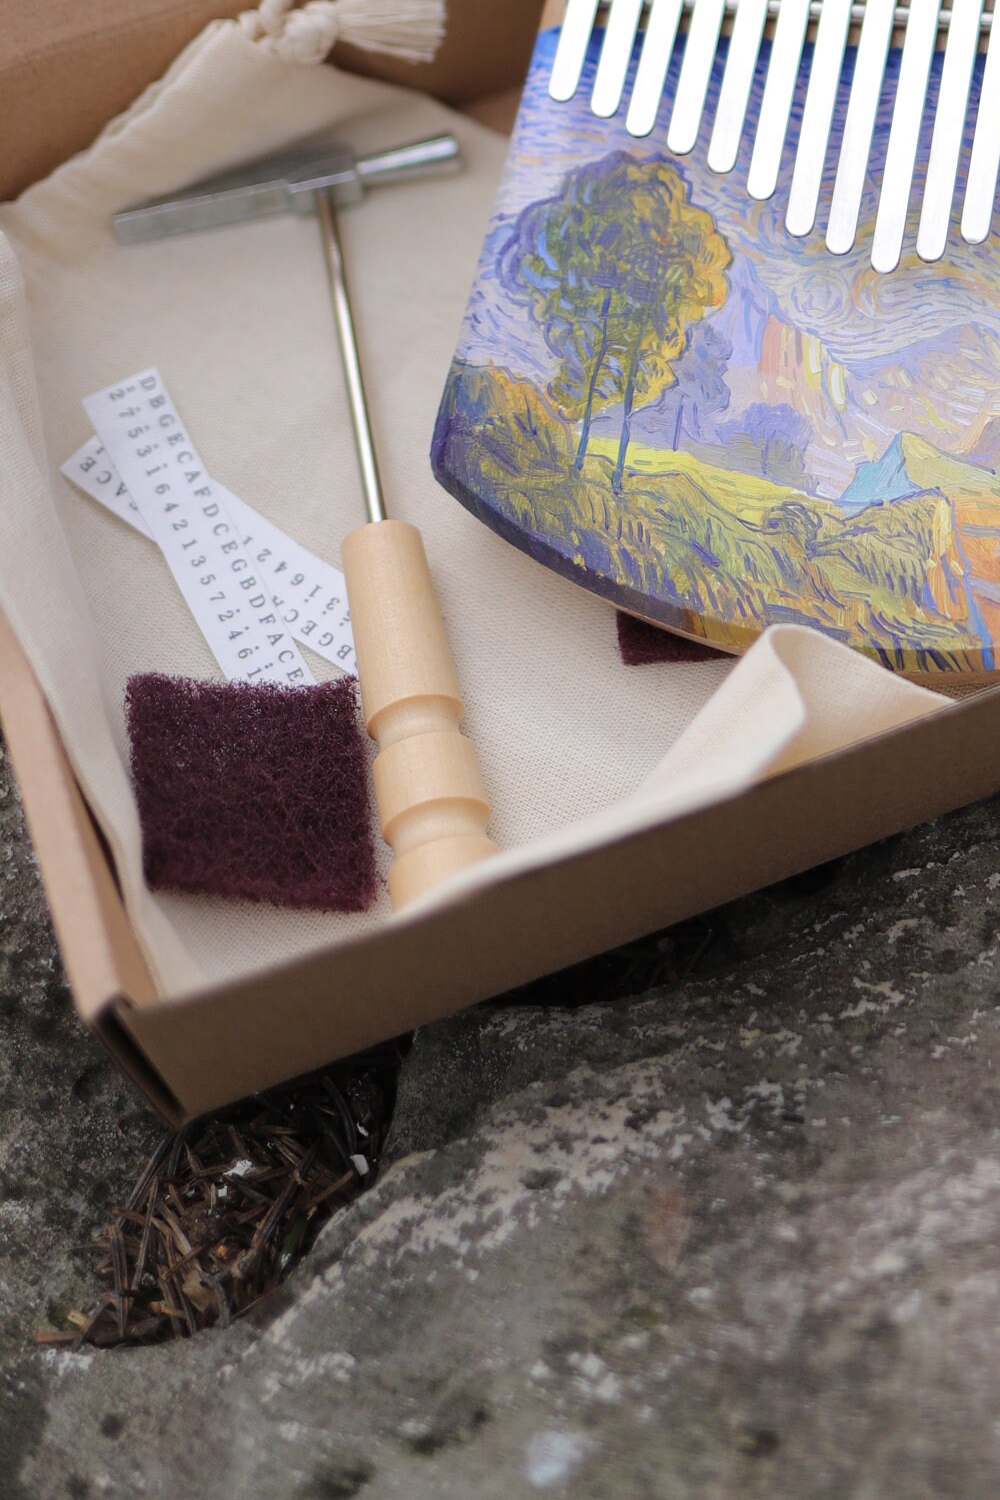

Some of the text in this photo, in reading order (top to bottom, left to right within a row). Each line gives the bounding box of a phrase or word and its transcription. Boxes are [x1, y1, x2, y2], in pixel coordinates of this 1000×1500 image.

[139, 376, 305, 683] D B G E C A F D C E G B D F A C E
[155, 483, 171, 495] 6
[164, 502, 179, 513] 4
[172, 518, 189, 532] 2
[181, 539, 198, 550] 1
[190, 555, 207, 568] 3
[199, 573, 217, 586] 5
[209, 591, 226, 602] 7
